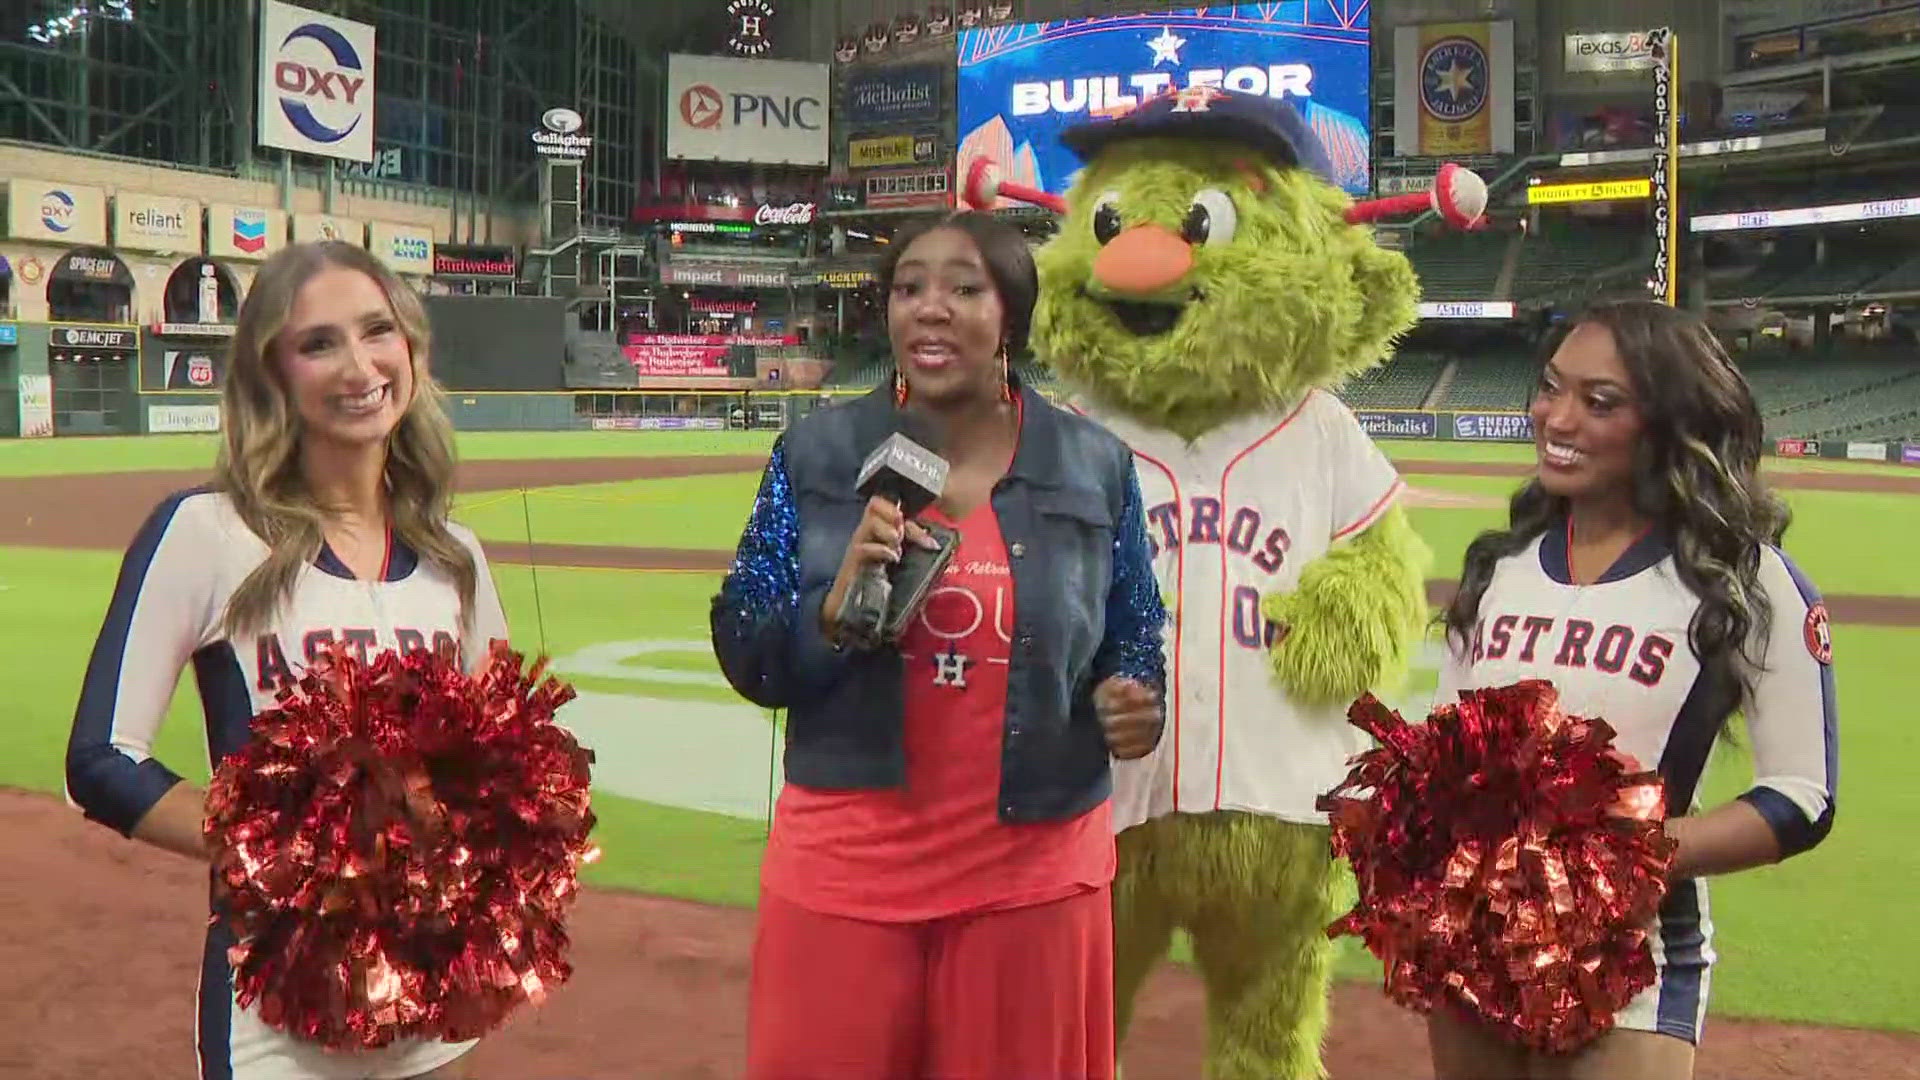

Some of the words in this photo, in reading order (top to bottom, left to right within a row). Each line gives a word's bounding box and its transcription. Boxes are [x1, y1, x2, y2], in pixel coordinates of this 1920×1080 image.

[741, 15, 761, 36] H
[275, 61, 364, 104] OXY
[1012, 73, 1171, 115] BUILT
[1653, 66, 1670, 126] ROOT
[732, 93, 821, 131] PNC
[532, 131, 592, 146] Gallagher
[42, 205, 73, 217] OXY
[129, 209, 183, 229] reliant
[1654, 206, 1668, 297] CHIKIN
[435, 258, 514, 274] Budweiser
[673, 269, 722, 285] impact
[738, 271, 785, 287] impact
[1436, 303, 1483, 317] ASTROS
[657, 335, 708, 346] Budweiser
[933, 653, 967, 687] H
